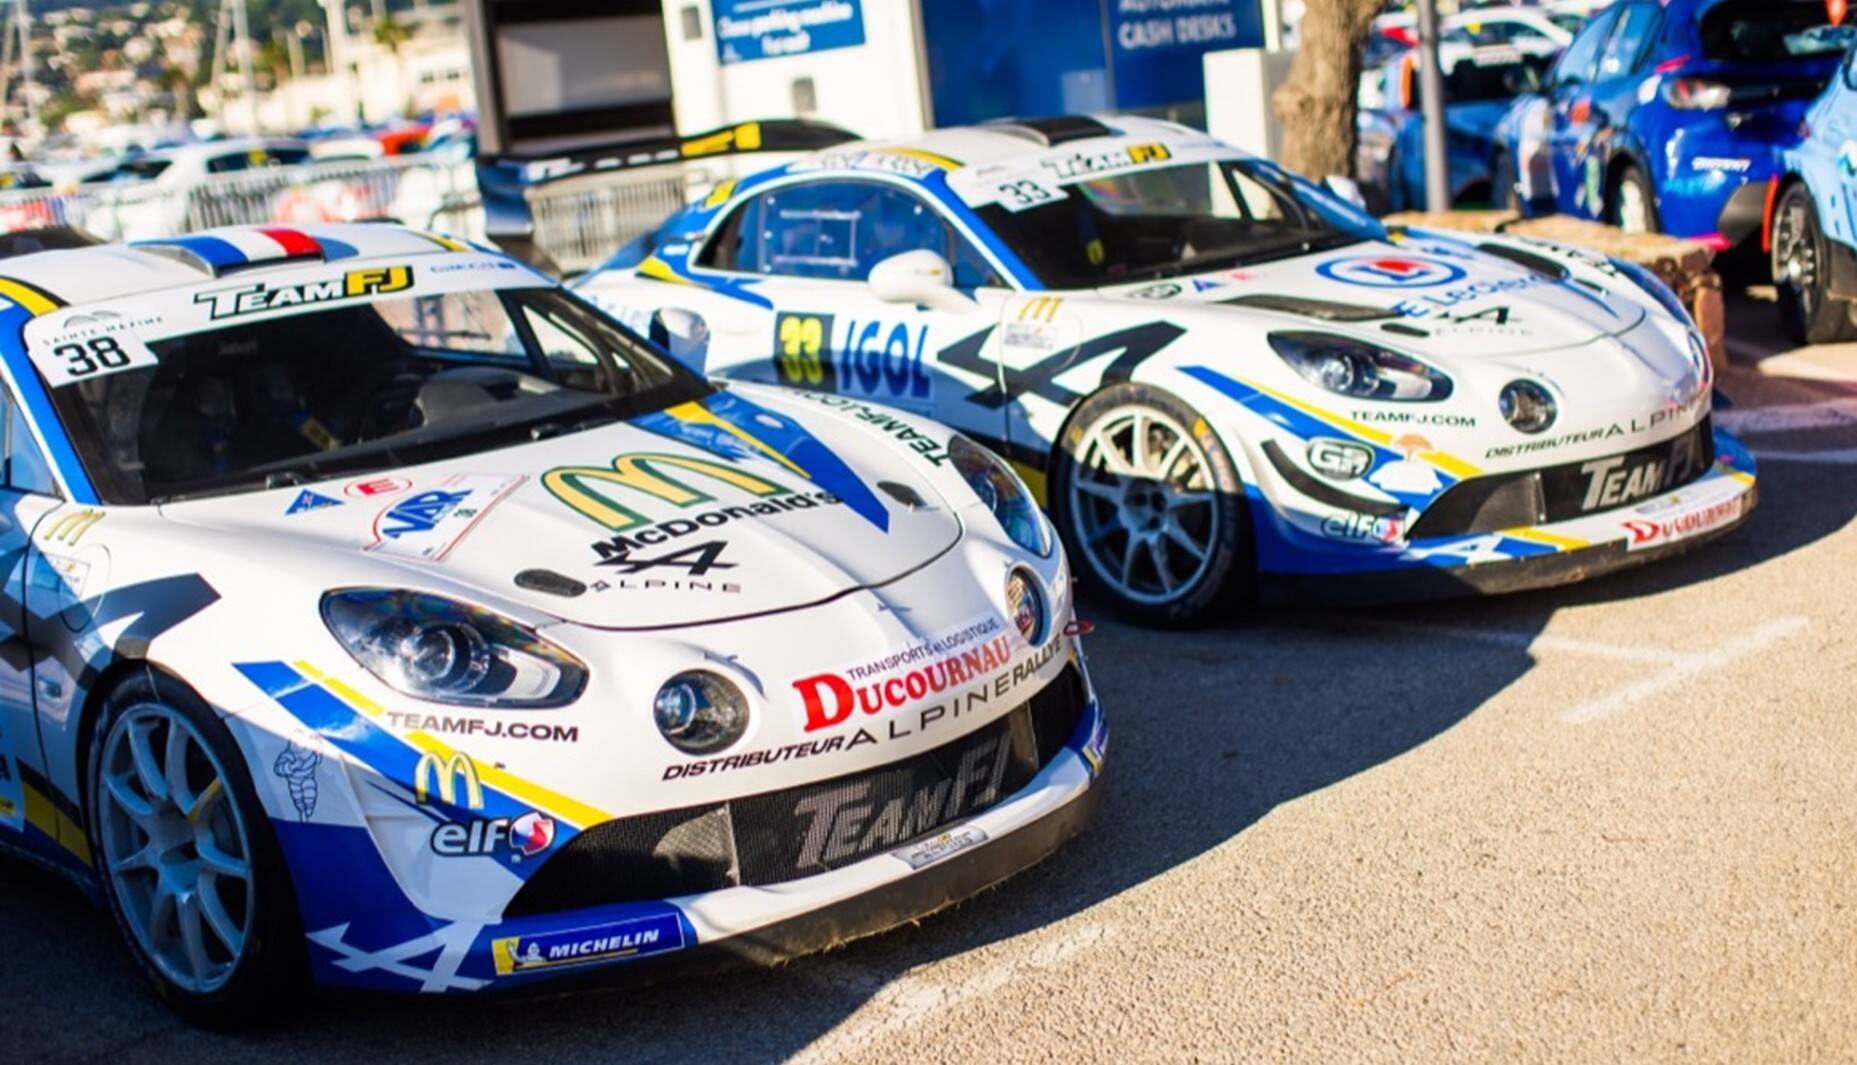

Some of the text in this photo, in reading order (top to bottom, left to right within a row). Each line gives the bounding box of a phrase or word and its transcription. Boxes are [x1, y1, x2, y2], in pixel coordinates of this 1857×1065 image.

[999, 179, 1050, 205] 33
[53, 336, 131, 377] 38
[779, 315, 823, 384] 33
[840, 320, 931, 398] IGOL
[1350, 410, 1476, 428] TEAMFJ.COM
[1485, 428, 1605, 460] DISTRIBUTEUR
[590, 488, 843, 560] McDonald's
[845, 641, 934, 681] TRANSPORTS
[791, 635, 1012, 733] DUCOURNAU
[387, 710, 579, 743] TEAMFJ.COM
[661, 633, 1062, 782] DISTRIBUTEUR ALPINE RALLYE
[430, 817, 511, 857] elf
[548, 928, 660, 960] MICHELIN
